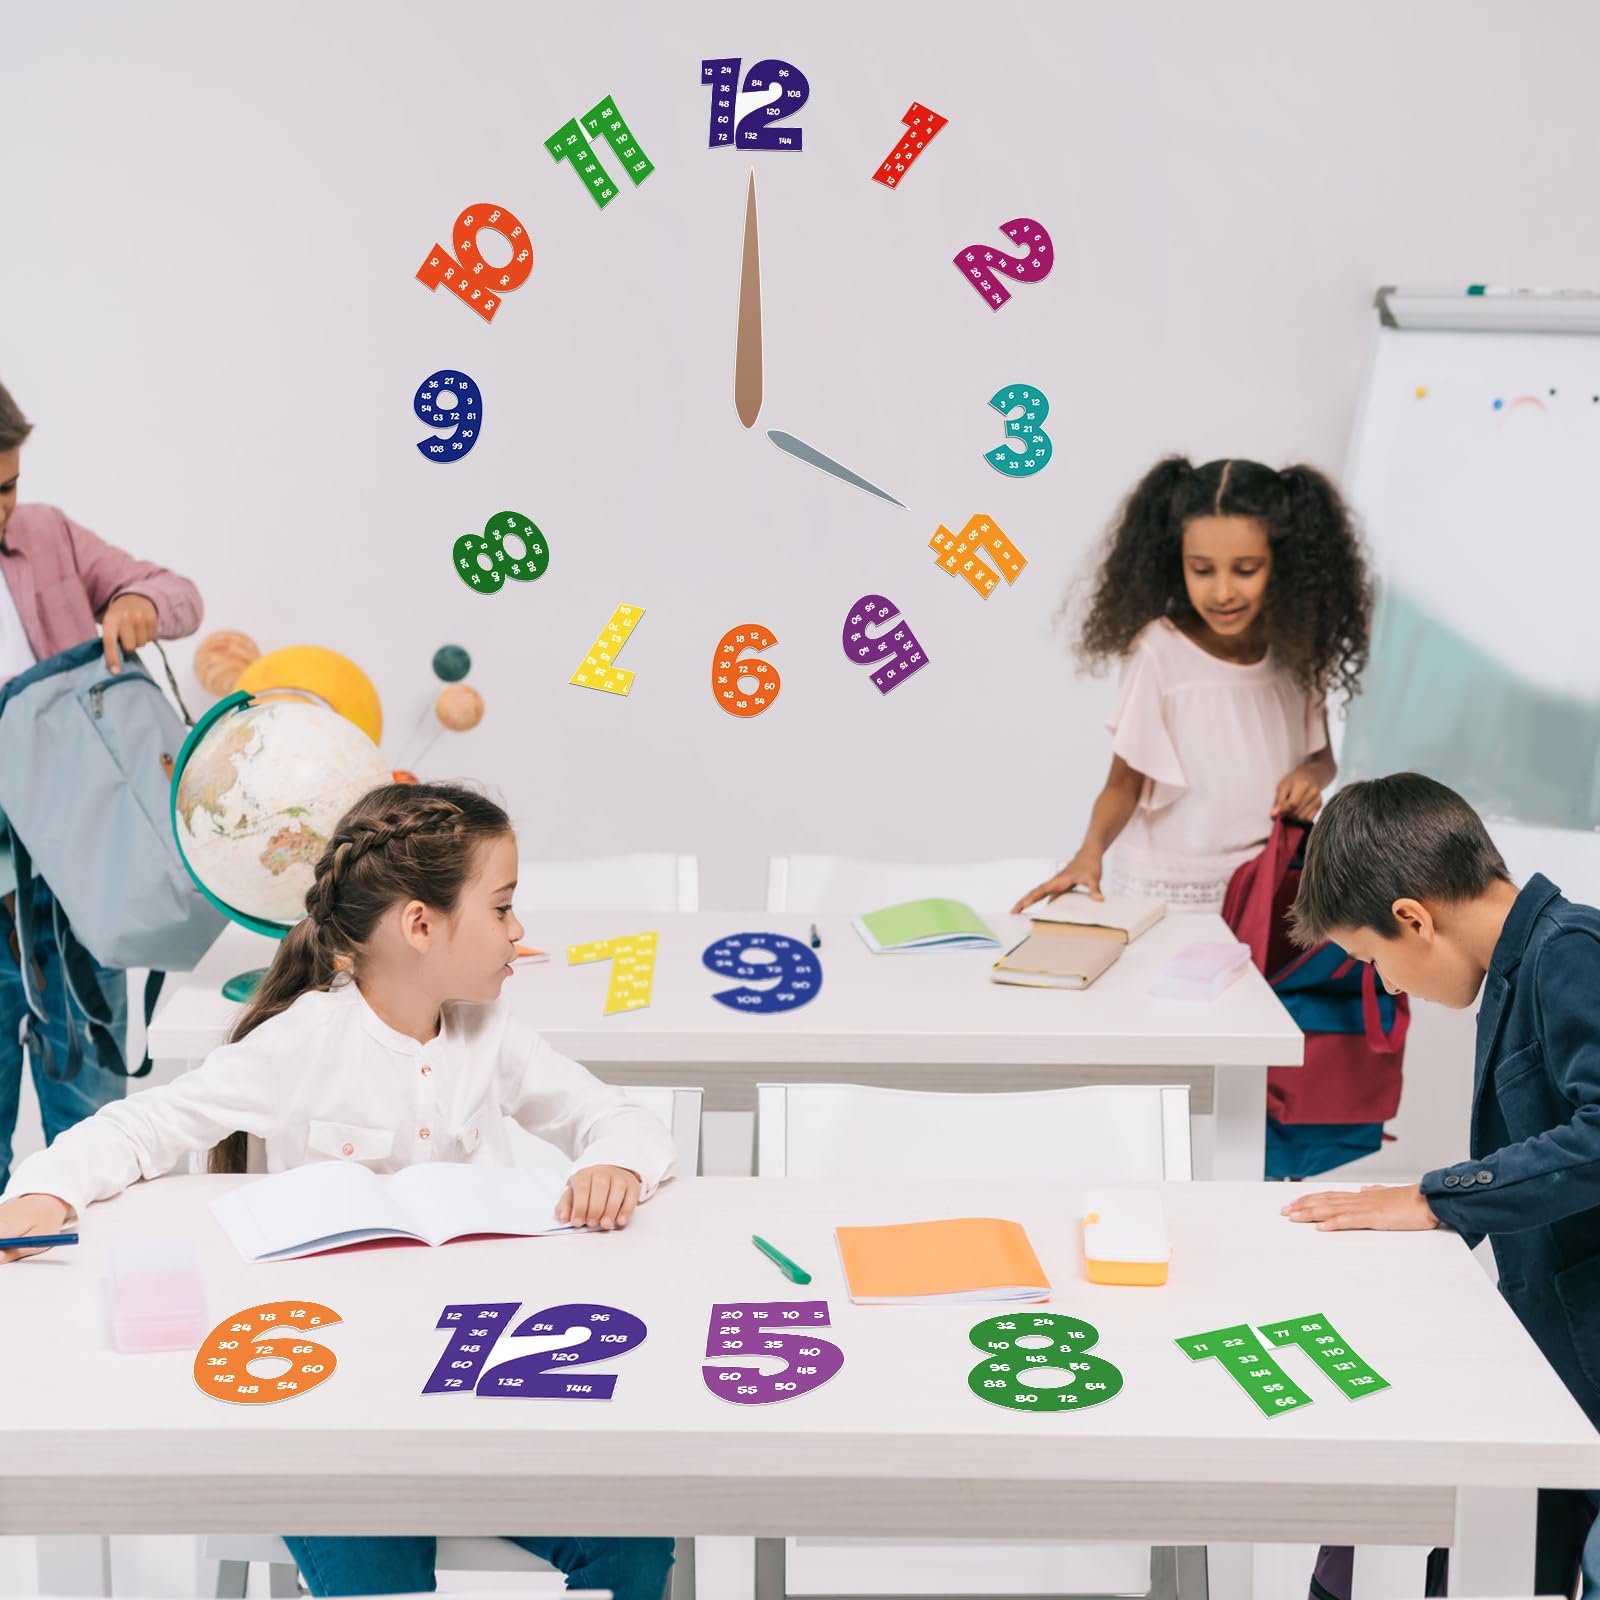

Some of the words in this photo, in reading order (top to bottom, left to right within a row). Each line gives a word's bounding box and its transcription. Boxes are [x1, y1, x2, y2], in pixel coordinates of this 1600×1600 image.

[704, 68, 713, 76] 12
[721, 66, 732, 74] 24
[779, 69, 789, 77] 96
[751, 79, 762, 87] 84
[720, 84, 730, 92] 36
[787, 90, 801, 98] 108
[701, 57, 810, 151] 12
[718, 100, 730, 108] 48
[601, 108, 613, 118] 88
[766, 108, 780, 116] 120
[589, 119, 597, 128] 77
[611, 121, 621, 131] 99
[566, 135, 578, 145] 22
[616, 133, 628, 144] 110
[718, 133, 728, 141] 72
[744, 132, 758, 140] 132
[779, 137, 792, 145] 144
[870, 100, 950, 190] 1
[543, 95, 655, 209] 11
[554, 144, 562, 152] 11
[624, 147, 636, 158] 121
[577, 151, 587, 160] 33
[585, 164, 596, 173] 44
[633, 161, 646, 172] 132
[895, 163, 904, 172] 10
[593, 177, 604, 187] 55
[601, 188, 612, 198] 66
[464, 215, 473, 226] 60
[489, 210, 501, 223] 120
[511, 226, 522, 238] 110
[461, 241, 471, 250] 70
[517, 249, 529, 263] 100
[414, 201, 535, 323] 10
[430, 257, 439, 267] 10
[952, 216, 1055, 311] 2
[1032, 258, 1041, 268] 10
[473, 263, 483, 274] 80
[970, 267, 981, 278] 20
[444, 268, 454, 280] 20
[500, 275, 510, 286] 90
[458, 280, 468, 291] 30
[471, 289, 481, 300] 40
[484, 300, 495, 311] 50
[444, 377, 454, 385] 27
[459, 382, 468, 390] 18
[421, 392, 432, 400] 45
[1023, 391, 1028, 399] 9
[467, 397, 473, 405] 9
[1031, 398, 1040, 406] 12
[412, 368, 484, 464] 9
[450, 412, 460, 420] 72
[467, 412, 476, 420] 81
[984, 382, 1054, 478] 3
[1023, 425, 1032, 433] 21
[462, 430, 473, 438] 90
[1032, 435, 1043, 443] 24
[430, 445, 444, 453] 108
[452, 442, 463, 450] 99
[1009, 461, 1019, 469] 33
[1025, 459, 1035, 467] 30
[968, 529, 978, 540] 20
[452, 511, 550, 594] 8
[532, 543, 542, 555] 80
[927, 512, 1029, 600] 4
[526, 561, 537, 572] 88
[878, 607, 889, 617] 60
[842, 594, 929, 694] 5
[569, 602, 646, 697] 7
[910, 652, 921, 663] 20
[720, 661, 731, 669] 30
[710, 622, 783, 718] 6
[764, 682, 775, 690] 60
[566, 929, 660, 1016] 7
[702, 931, 823, 1014] 9
[260, 1313, 276, 1321] 18
[290, 1309, 306, 1318] 12
[721, 1310, 743, 1319] 20
[752, 1311, 768, 1319] 15
[782, 1311, 800, 1319] 10
[814, 1311, 824, 1319] 5
[310, 1317, 321, 1325] 6
[996, 1321, 1016, 1330] 32
[1033, 1318, 1054, 1326] 24
[230, 1323, 252, 1332] 24
[532, 1323, 553, 1331] 84
[719, 1326, 741, 1335] 25
[1301, 1323, 1322, 1332] 88
[469, 1329, 488, 1337] 36
[1067, 1331, 1085, 1339] 16
[1274, 1330, 1289, 1338] 77
[600, 1334, 628, 1343] 108
[1223, 1338, 1245, 1347] 22
[1315, 1336, 1334, 1344] 99
[217, 1341, 239, 1349] 30
[460, 1345, 481, 1353] 48
[722, 1340, 743, 1349] 30
[763, 1340, 783, 1349] 35
[988, 1341, 1010, 1349] 40
[1060, 1345, 1072, 1353] 8
[192, 1299, 344, 1405] 6
[256, 1346, 274, 1354] 72
[292, 1345, 313, 1354] 66
[422, 1301, 648, 1400] 12
[701, 1300, 845, 1405] 5
[799, 1347, 821, 1357] 40
[1322, 1348, 1344, 1357] 110
[207, 1357, 227, 1366] 36
[551, 1353, 579, 1361] 120
[1026, 1355, 1048, 1363] 48
[1238, 1355, 1259, 1364] 33
[451, 1361, 473, 1369] 60
[967, 1312, 1124, 1412] 8
[1069, 1362, 1091, 1371] 56
[1174, 1311, 1392, 1418] 11
[1333, 1361, 1356, 1371] 121
[302, 1364, 324, 1373] 60
[796, 1366, 817, 1375] 45
[989, 1363, 1011, 1372] 96
[719, 1372, 742, 1381] 60
[1250, 1369, 1271, 1377] 44
[214, 1375, 235, 1383] 42
[444, 1379, 463, 1387] 72
[498, 1378, 524, 1387] 132
[984, 1379, 1007, 1388] 88
[1349, 1376, 1375, 1386] 132
[237, 1385, 259, 1393] 48
[277, 1382, 297, 1390] 54
[566, 1384, 592, 1393] 144
[737, 1385, 758, 1395] 55
[775, 1382, 797, 1391] 50
[1085, 1382, 1107, 1390] 64
[1263, 1383, 1284, 1393] 55
[1015, 1394, 1038, 1403] 80
[1057, 1394, 1078, 1403] 72
[1275, 1397, 1297, 1406] 66
